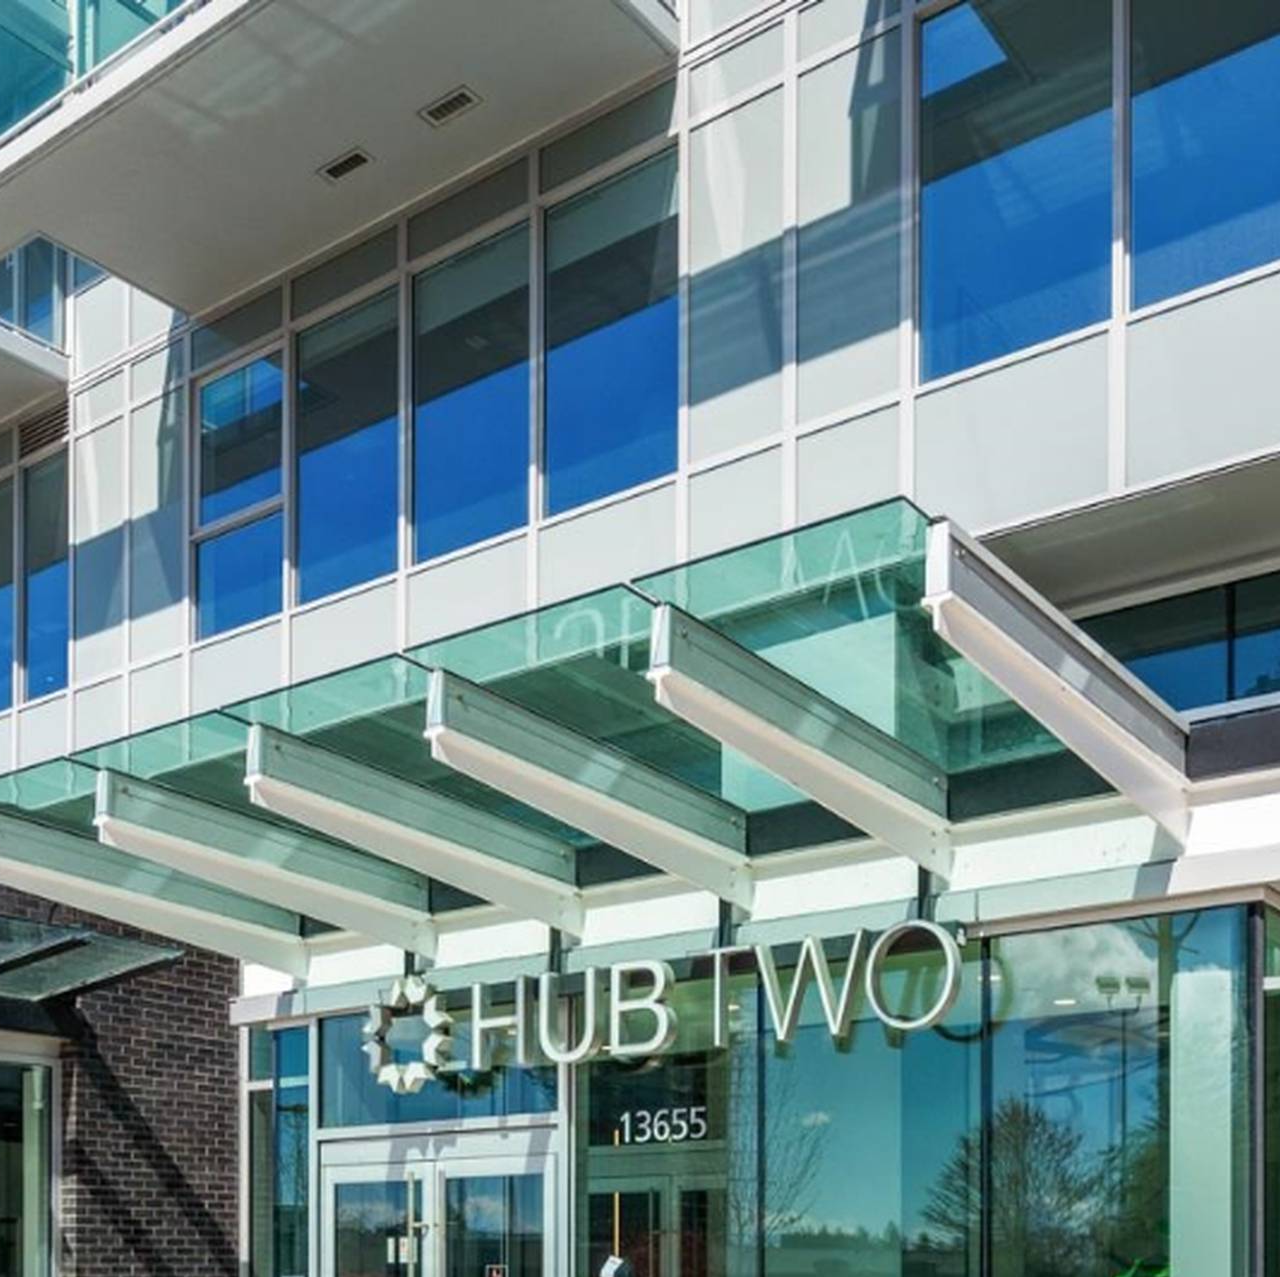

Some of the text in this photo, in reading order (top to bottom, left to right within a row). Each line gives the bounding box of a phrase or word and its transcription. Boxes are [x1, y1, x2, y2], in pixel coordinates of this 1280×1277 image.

[471, 920, 963, 1071] HUB TWO
[618, 1106, 708, 1144] 13655
